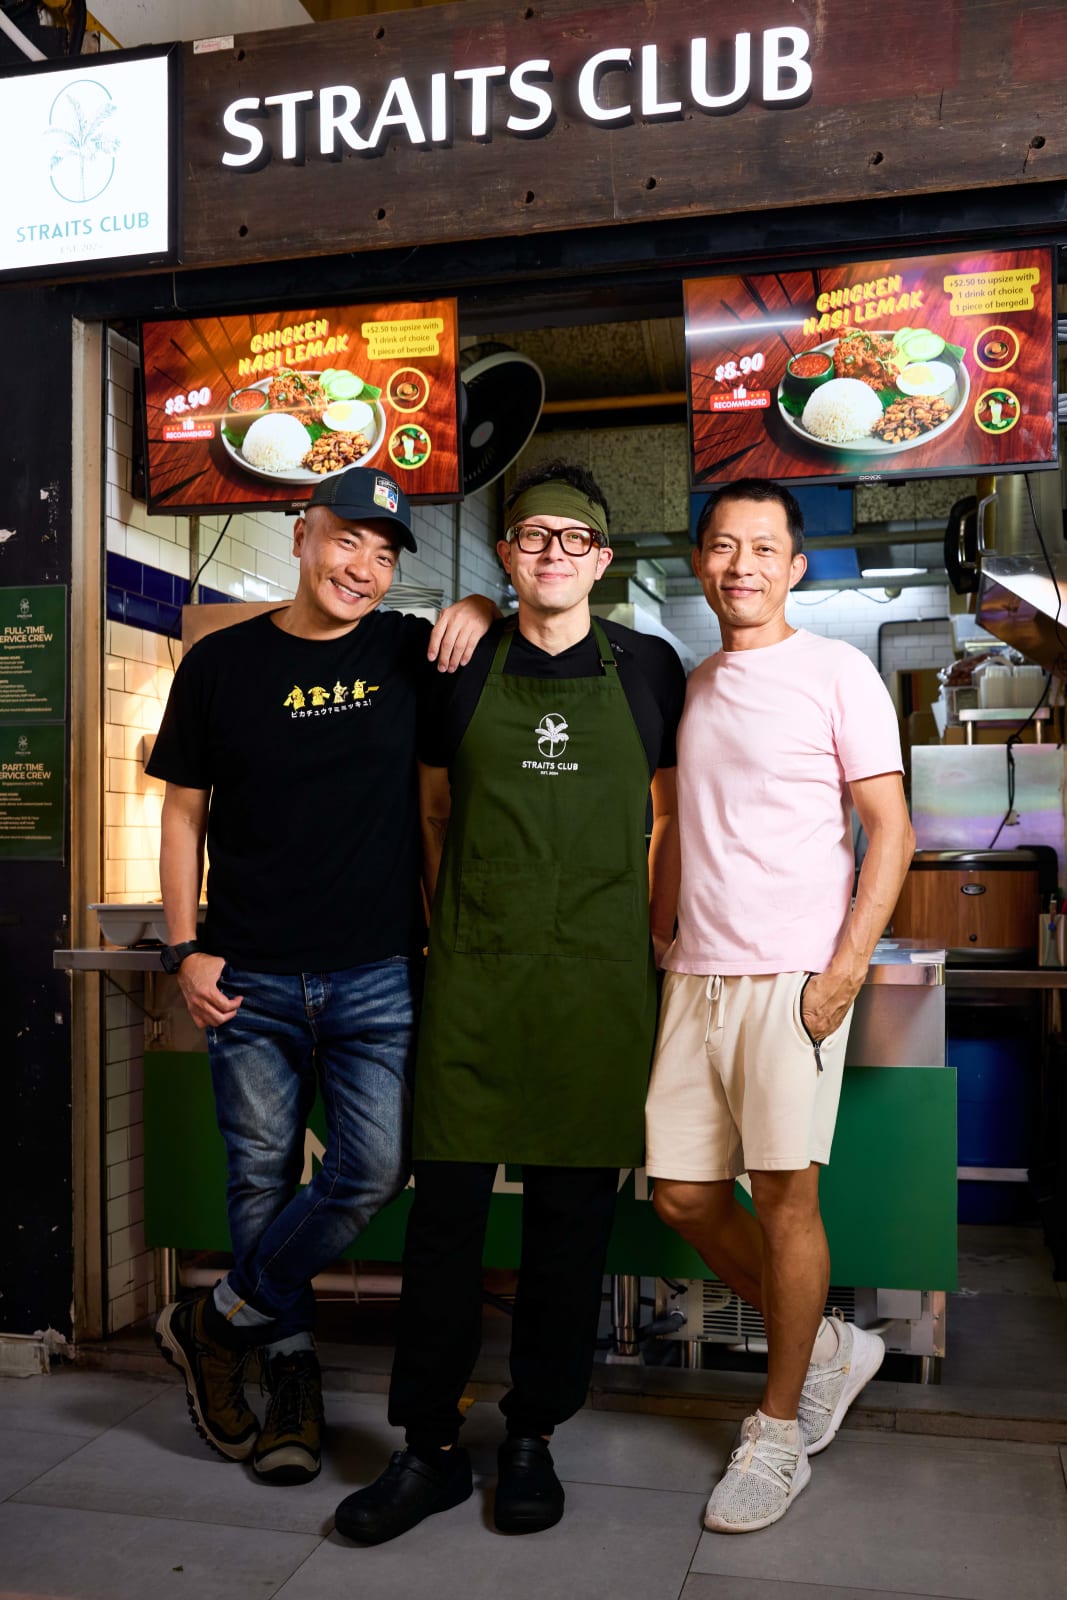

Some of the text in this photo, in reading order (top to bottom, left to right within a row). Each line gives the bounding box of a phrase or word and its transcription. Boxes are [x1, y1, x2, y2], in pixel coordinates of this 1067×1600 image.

[221, 26, 813, 168] STRAITS CLUB
[16, 211, 149, 243] STRAITS CLUB
[950, 272, 1035, 288] +$2.50 to upsize with
[815, 274, 903, 314] CHICKEN
[958, 286, 1024, 299] 1 drink of choice
[802, 289, 925, 337] NASI LEMAK
[956, 297, 1029, 313] 1 piece of bergedil
[250, 318, 329, 354] CHICKEN
[366, 322, 439, 334] +$2.50 to upsize with
[379, 336, 398, 344] drink
[399, 335, 406, 343] of
[407, 334, 430, 343] choice
[237, 333, 350, 377] NASI LEMAK
[377, 347, 396, 357] piece
[397, 346, 405, 354] of
[406, 344, 435, 355] bergedil
[714, 352, 766, 383] $8.90
[165, 386, 212, 416] $8.90
[714, 399, 767, 409] RECOMMENDED
[166, 430, 213, 439] RECOMMENDED
[0, 633, 53, 643] ERVICE CREW
[522, 761, 578, 770] STRAITS CLUB
[0, 771, 52, 780] ERVICE CREW
